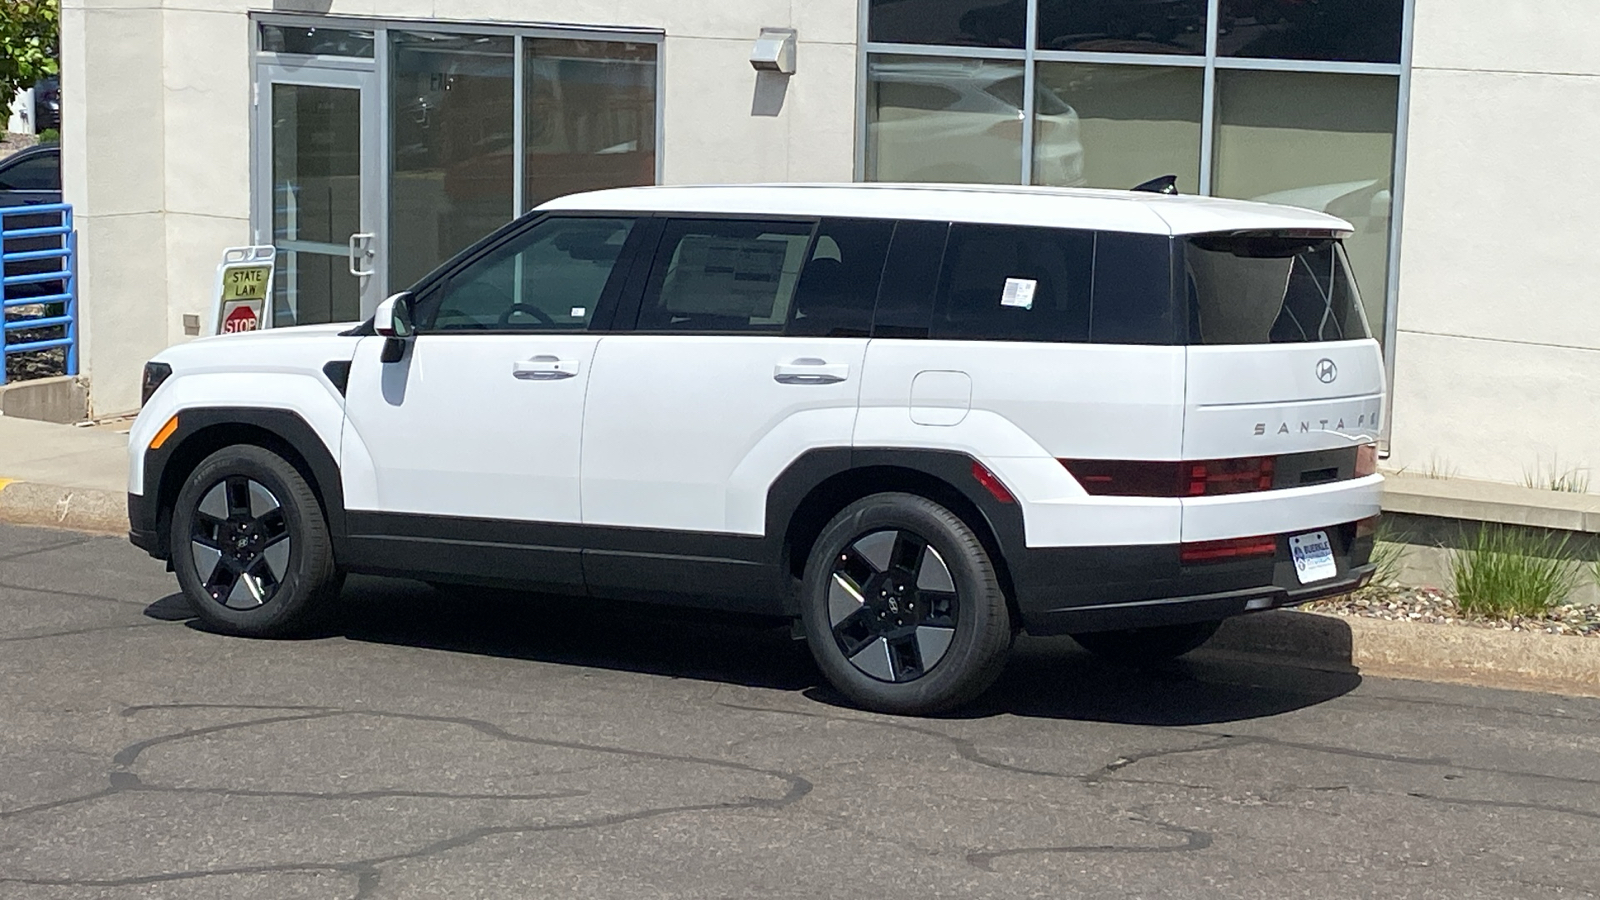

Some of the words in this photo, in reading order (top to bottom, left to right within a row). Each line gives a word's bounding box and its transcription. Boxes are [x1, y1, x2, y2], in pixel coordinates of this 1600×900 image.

[233, 270, 262, 283] STATE
[235, 285, 257, 296] LAW
[225, 318, 257, 334] STOP
[1253, 418, 1345, 436] SANTA
